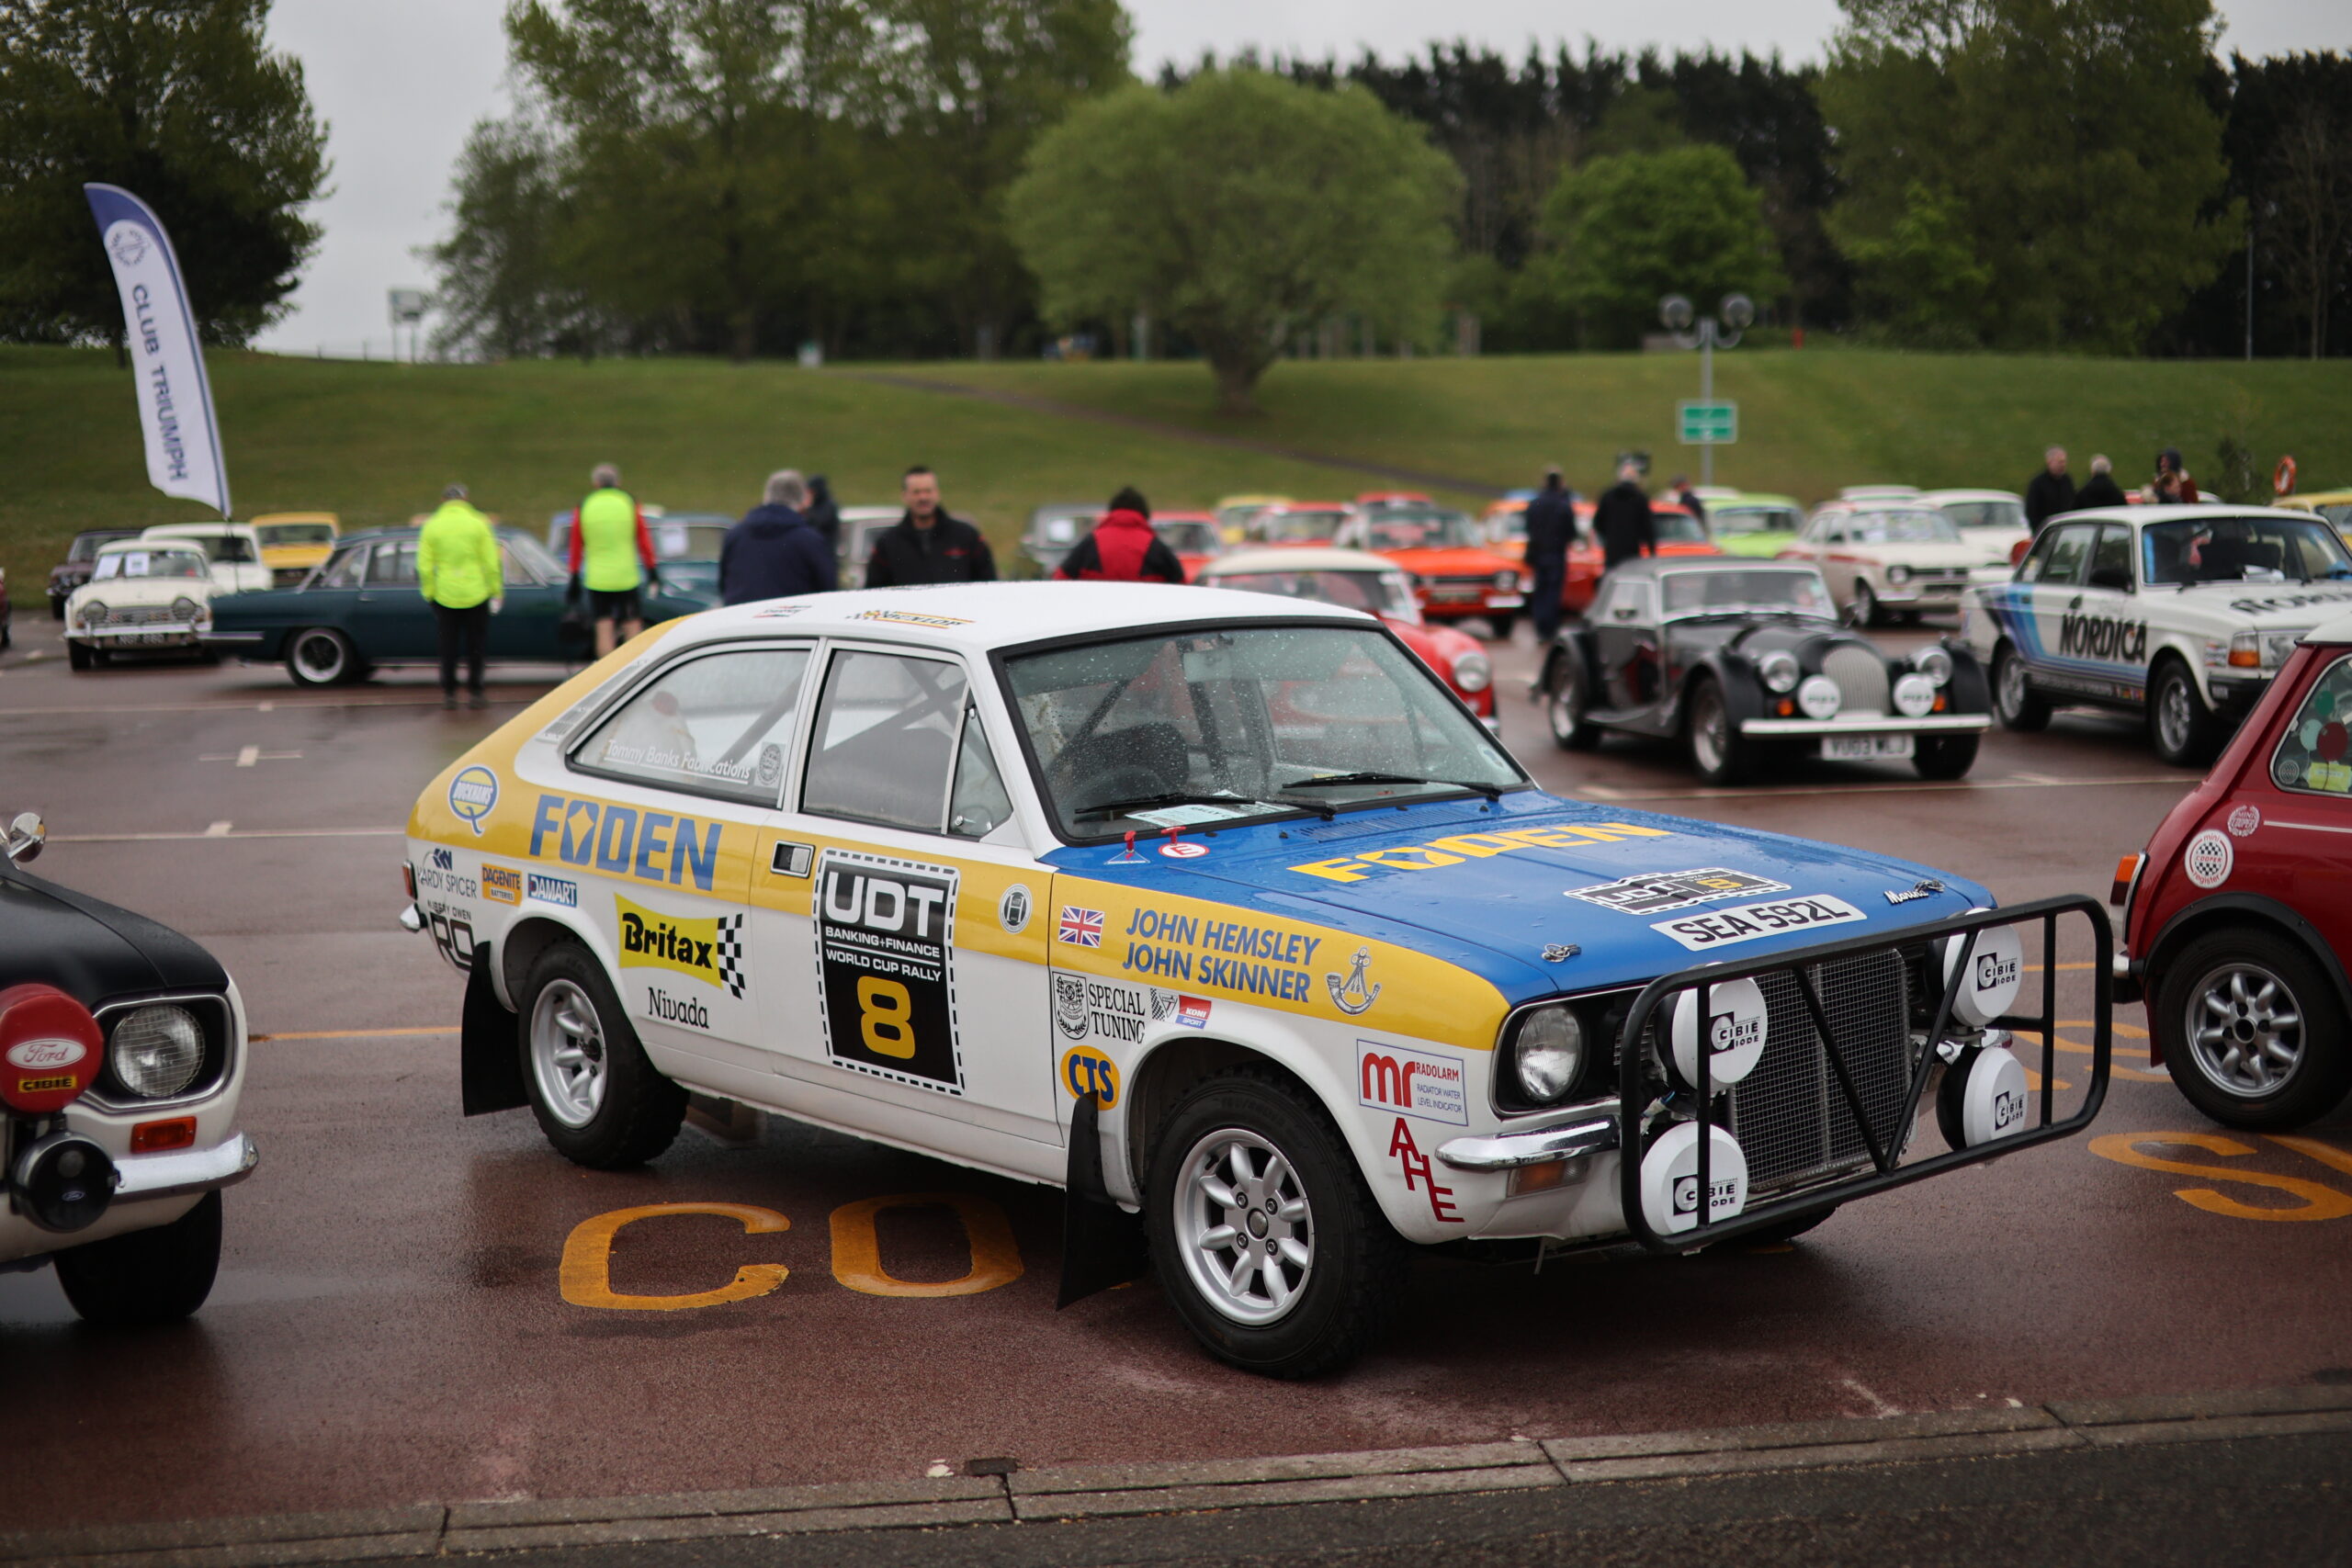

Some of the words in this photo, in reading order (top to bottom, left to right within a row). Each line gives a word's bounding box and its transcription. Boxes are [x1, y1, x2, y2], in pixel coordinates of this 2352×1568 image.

[131, 284, 160, 355] CLUB
[151, 364, 187, 481] TRIUMPH
[2060, 612, 2148, 663] NORDICA
[607, 739, 645, 763] Tommy
[647, 746, 680, 767] Banks
[681, 751, 751, 779] Fabrications
[529, 794, 722, 891] FODEN
[2203, 833, 2221, 842] mini
[1286, 823, 1673, 883] FODEN
[446, 874, 477, 899] SPICER
[482, 866, 521, 890] DAGENITE
[1696, 878, 1743, 889] 8
[2193, 872, 2220, 885] register
[491, 888, 514, 901] BATTERIES
[530, 875, 576, 906] DAMART
[1596, 884, 1674, 902] UDT
[452, 907, 471, 921] OWEN
[826, 871, 944, 937] UDT
[1673, 917, 1759, 943] SEA
[1757, 898, 1851, 928] 592L
[623, 912, 713, 970] Britax
[826, 927, 940, 958] BANKING+FINANCE
[1125, 908, 1198, 945] JOHN
[1203, 920, 1322, 965] HEMSLEY
[826, 948, 870, 969] WORLD
[873, 958, 899, 974] CUP
[902, 964, 942, 982] RALLY
[1123, 942, 1193, 979] JOHN
[1197, 955, 1313, 1003] SKINNER
[1985, 963, 2016, 978] CIBIE
[1997, 975, 2016, 985] IODE
[648, 987, 709, 1029] Nivada
[1089, 983, 1146, 1016] SPECIAL
[857, 976, 916, 1059] 8
[1182, 1017, 1204, 1027] SPORT
[1186, 1008, 1206, 1018] KONI
[1091, 1011, 1145, 1044] TUNING
[1720, 1022, 1758, 1041] CIBIE
[24, 1043, 70, 1063] Ford
[1736, 1035, 1759, 1047] IODE
[23, 1077, 73, 1090] CIBIE
[1069, 1054, 1113, 1102] CTS
[1416, 1062, 1459, 1082] RADOLARM
[1417, 1083, 1442, 1096] RADIATOR
[1442, 1088, 1462, 1100] WATER
[1418, 1098, 1432, 1108] LEVEL
[1432, 1100, 1463, 1113] INDICATOR
[1686, 1183, 1735, 1201] CBIE
